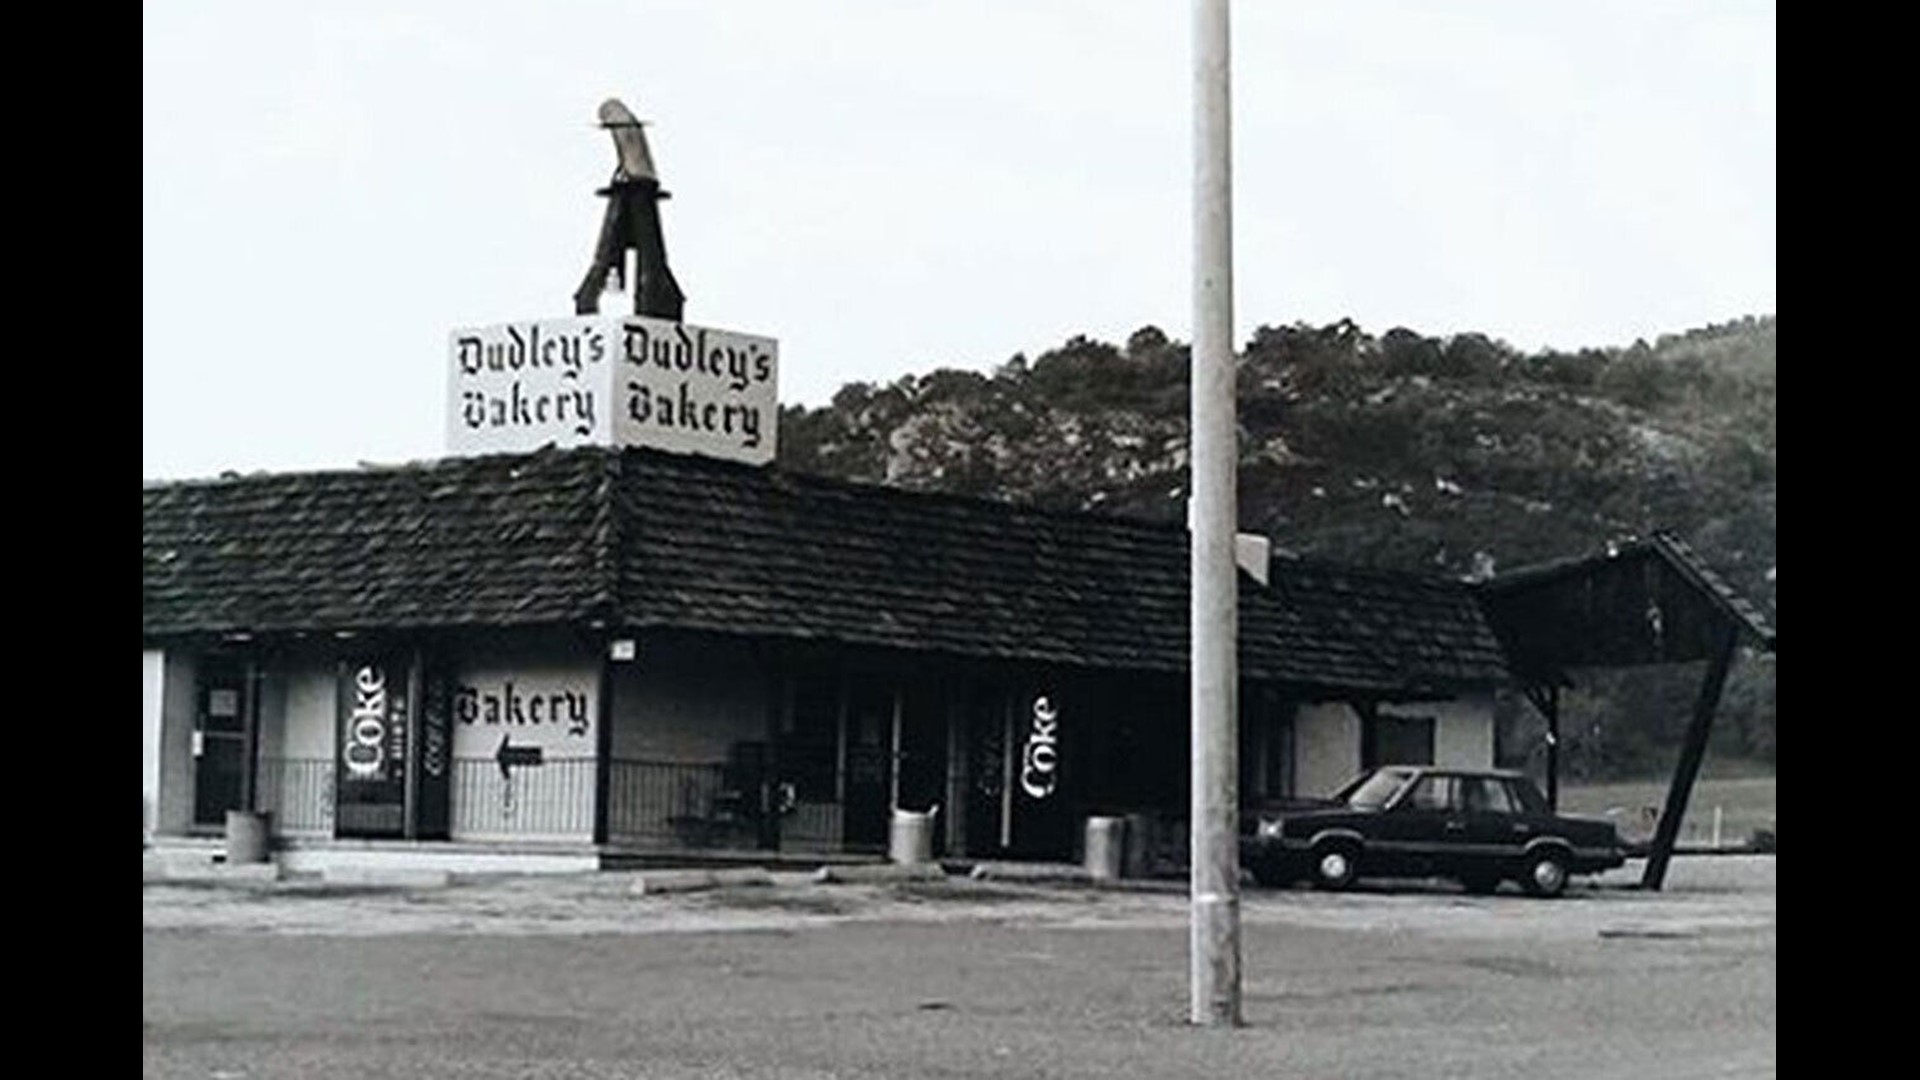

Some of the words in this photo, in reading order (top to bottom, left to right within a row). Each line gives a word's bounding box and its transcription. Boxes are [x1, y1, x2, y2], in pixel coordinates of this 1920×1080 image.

[458, 325, 604, 379] Dudley's
[623, 324, 771, 391] Dudley's
[463, 381, 596, 436] Bakery
[627, 382, 761, 449] Bakery
[344, 666, 385, 775] Coke
[456, 682, 590, 737] Bakery
[1021, 696, 1057, 798] Coke
